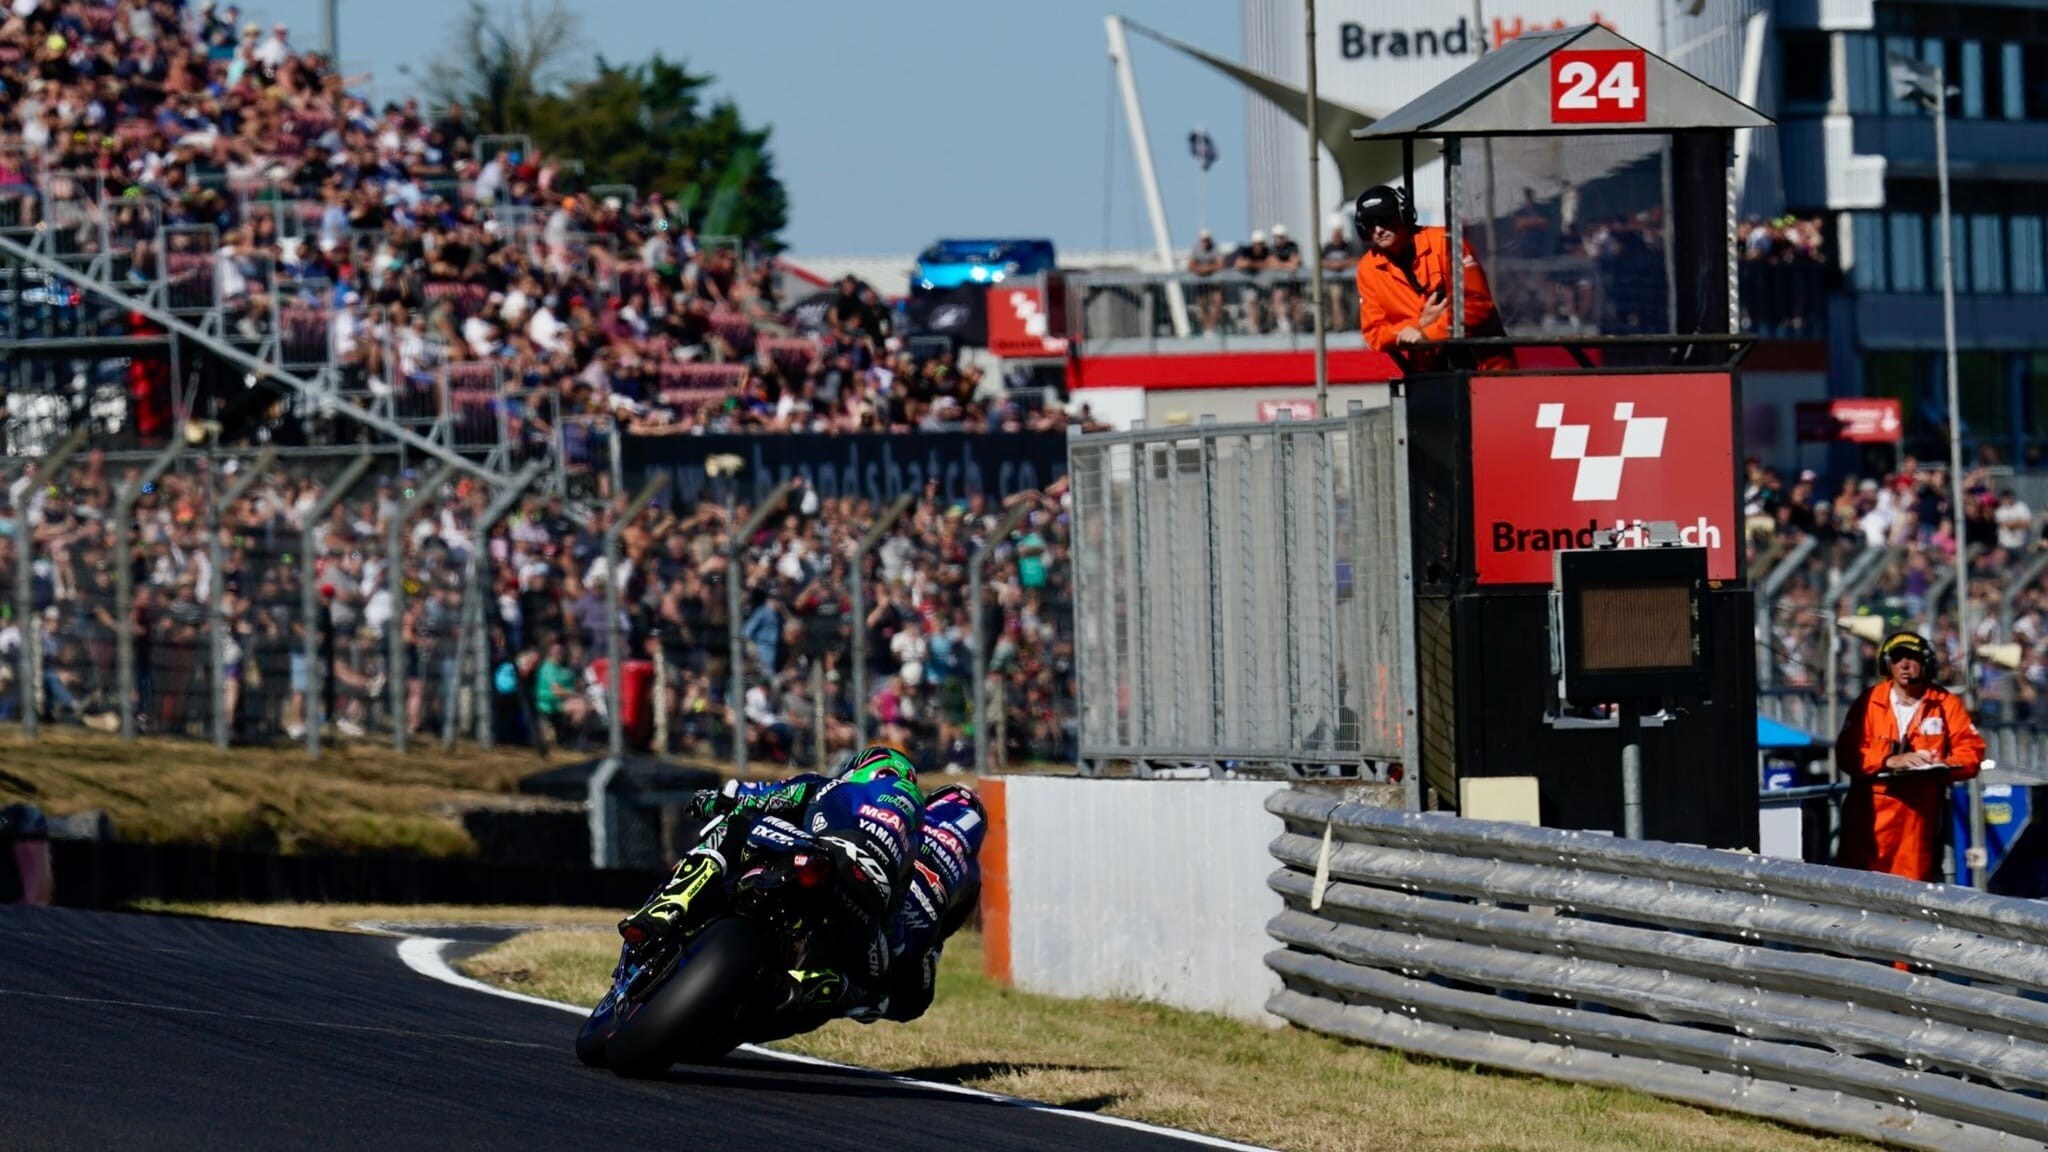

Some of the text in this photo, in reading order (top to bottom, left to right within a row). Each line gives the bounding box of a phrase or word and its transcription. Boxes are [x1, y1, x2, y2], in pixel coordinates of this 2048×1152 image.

[1557, 61, 1639, 109] 24
[858, 818, 903, 867] YAMAHA
[923, 835, 961, 881] YAMAHA
